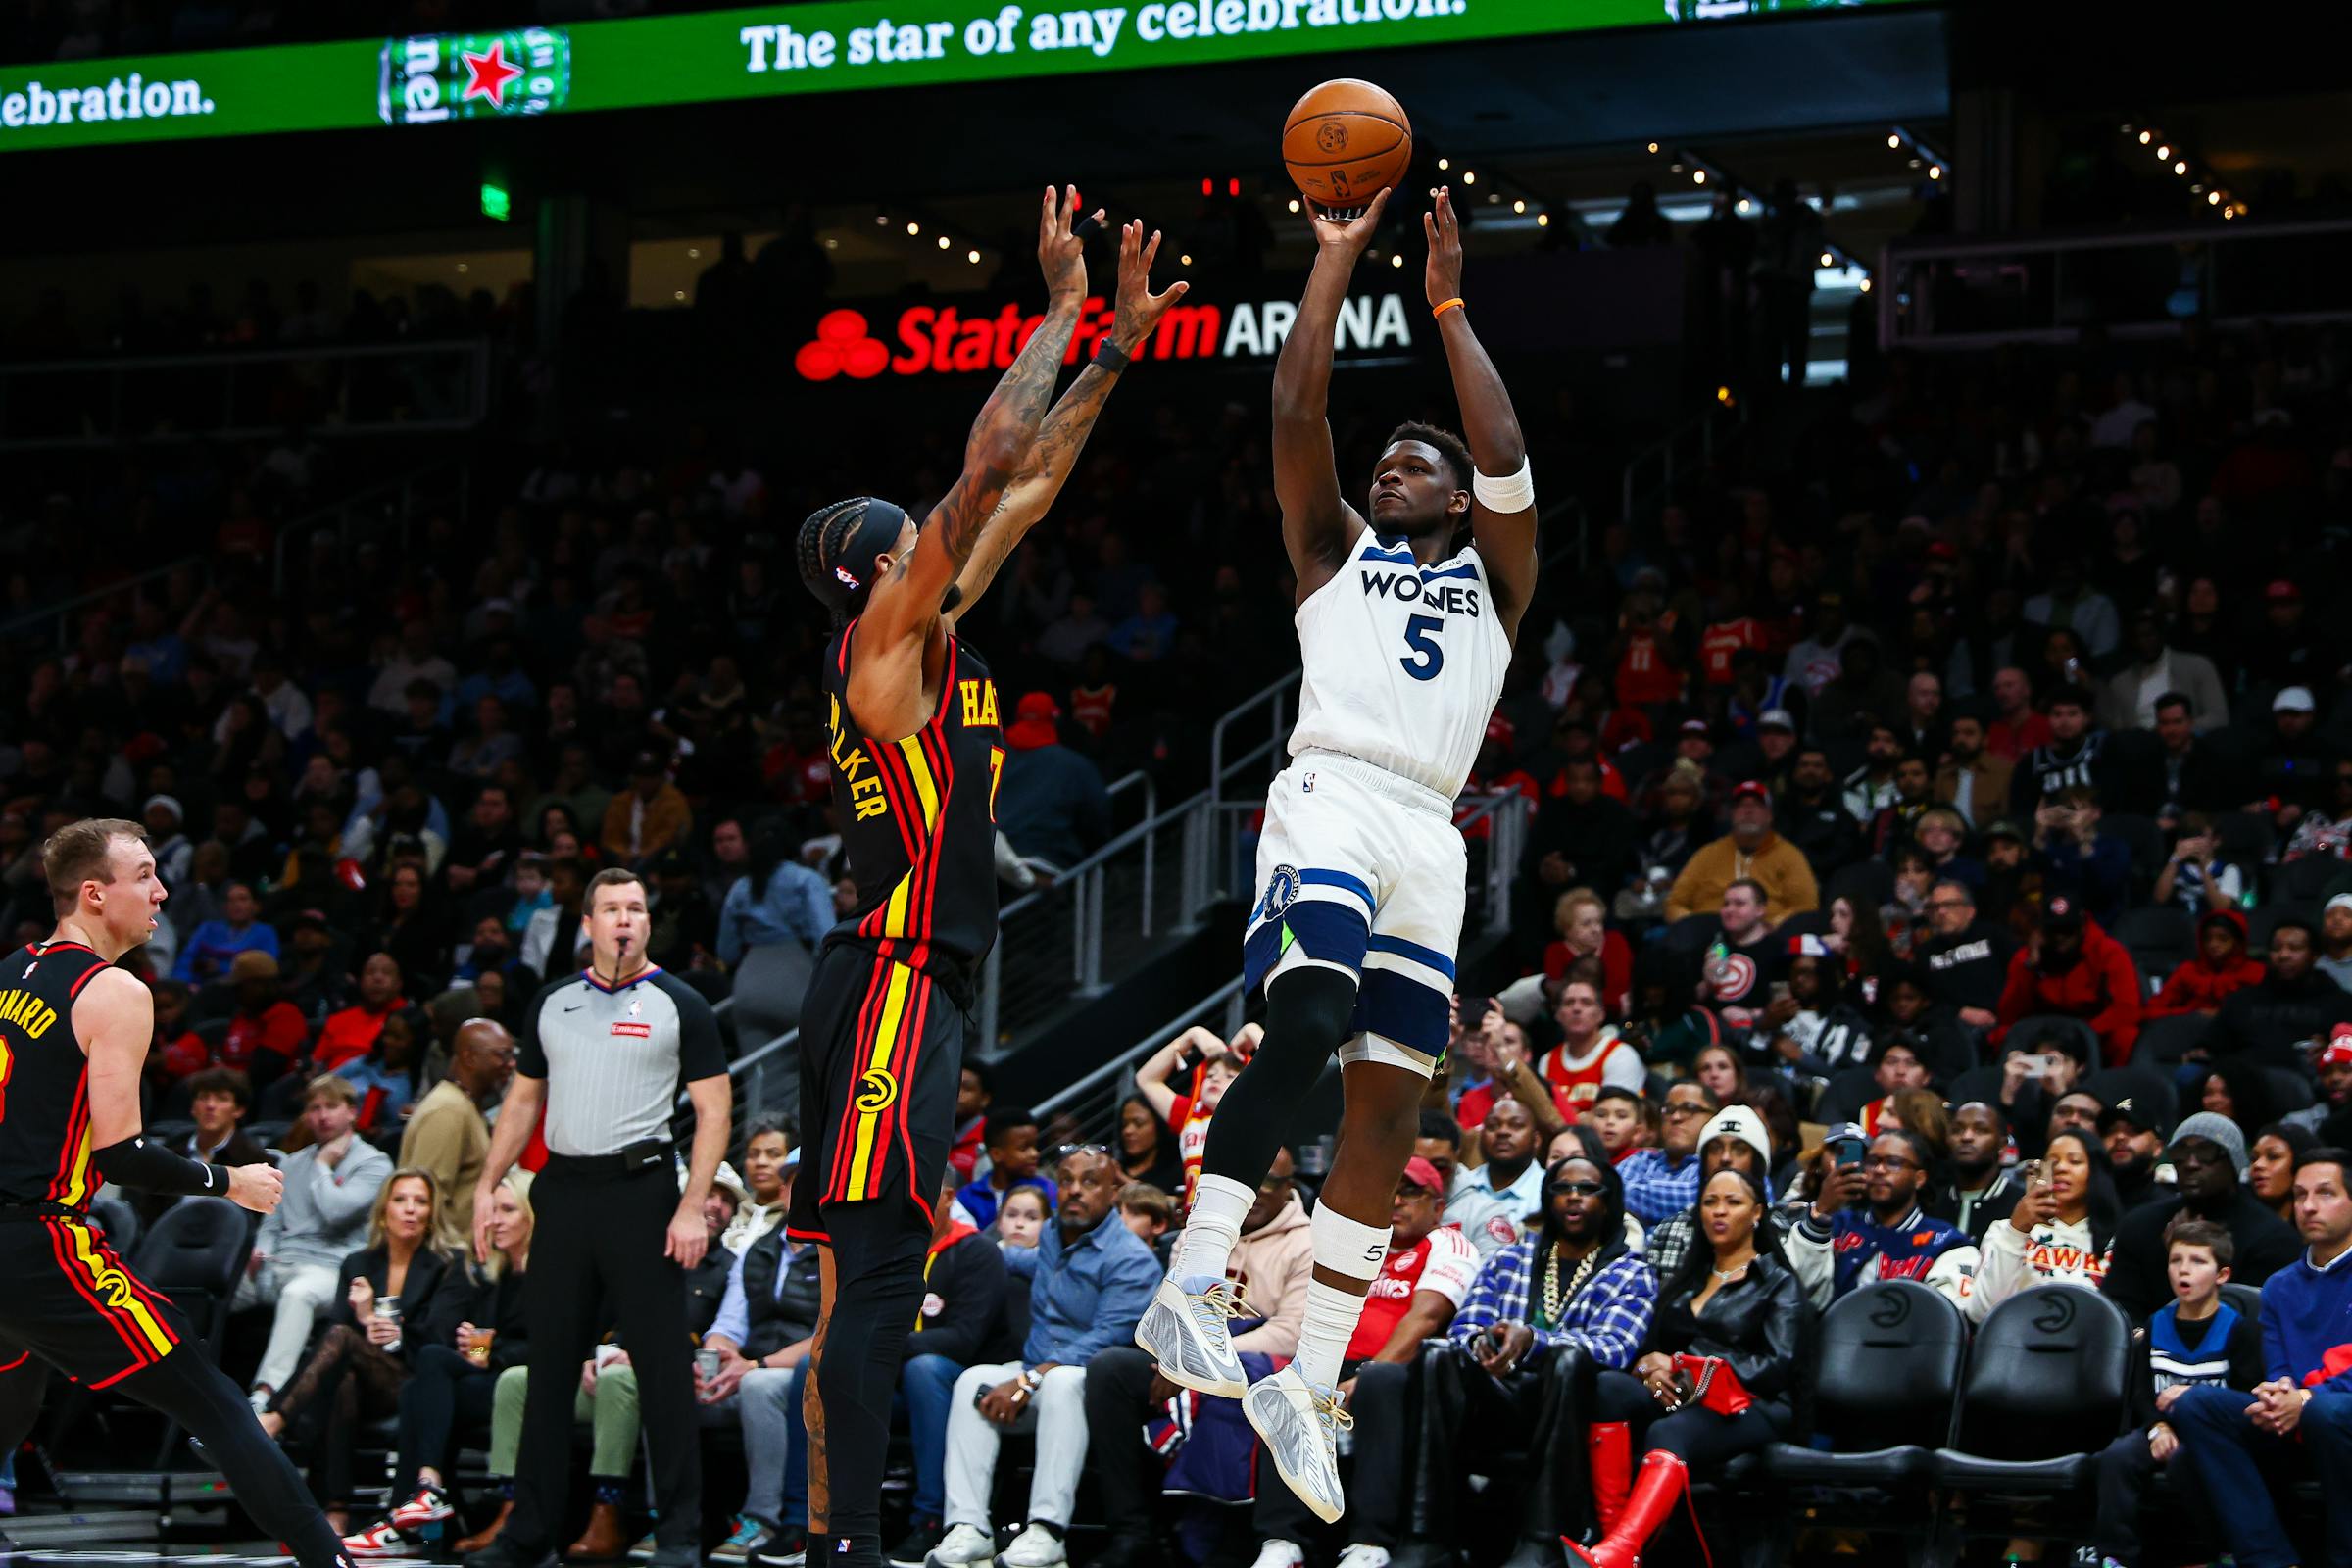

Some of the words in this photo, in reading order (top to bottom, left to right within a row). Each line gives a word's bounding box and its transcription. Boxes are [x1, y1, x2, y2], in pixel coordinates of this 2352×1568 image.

[740, 24, 836, 72] The
[848, 19, 954, 65] star
[964, 5, 1023, 55] of
[1029, 8, 1127, 56] any
[0, 72, 215, 127] ebration.
[1061, 296, 1221, 366] Fam
[1222, 293, 1411, 357] ARNA
[1399, 612, 1445, 681] 5
[990, 745, 1005, 823] 7
[1363, 1245, 1386, 1262] 5
